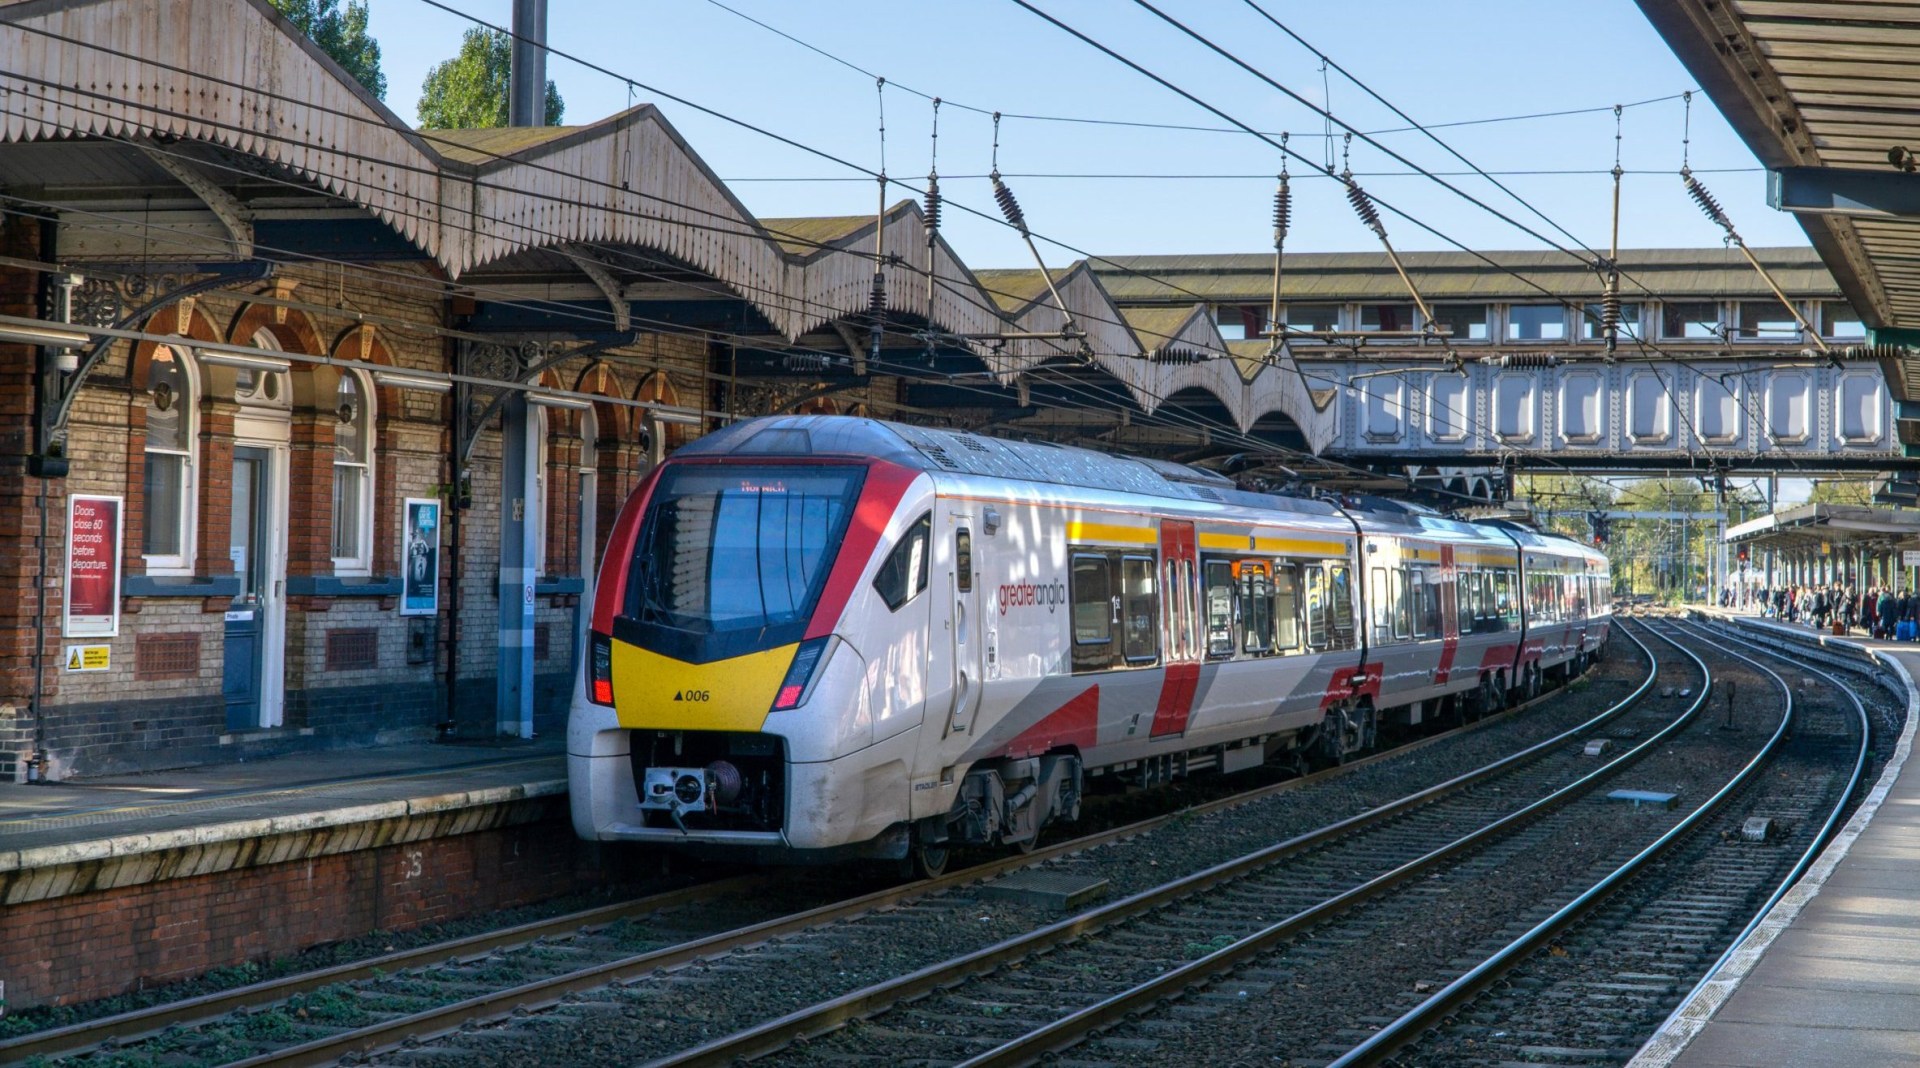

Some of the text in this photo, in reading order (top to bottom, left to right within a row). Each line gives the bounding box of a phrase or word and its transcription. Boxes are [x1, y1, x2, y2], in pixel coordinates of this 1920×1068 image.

[74, 504, 95, 517] Doors
[73, 519, 103, 530] close 60
[73, 533, 103, 543] seconds
[72, 545, 95, 556] before
[72, 558, 108, 572] departure.
[1000, 578, 1065, 616] greateranglia
[1111, 595, 1121, 623] 1st
[686, 690, 710, 702] 006
